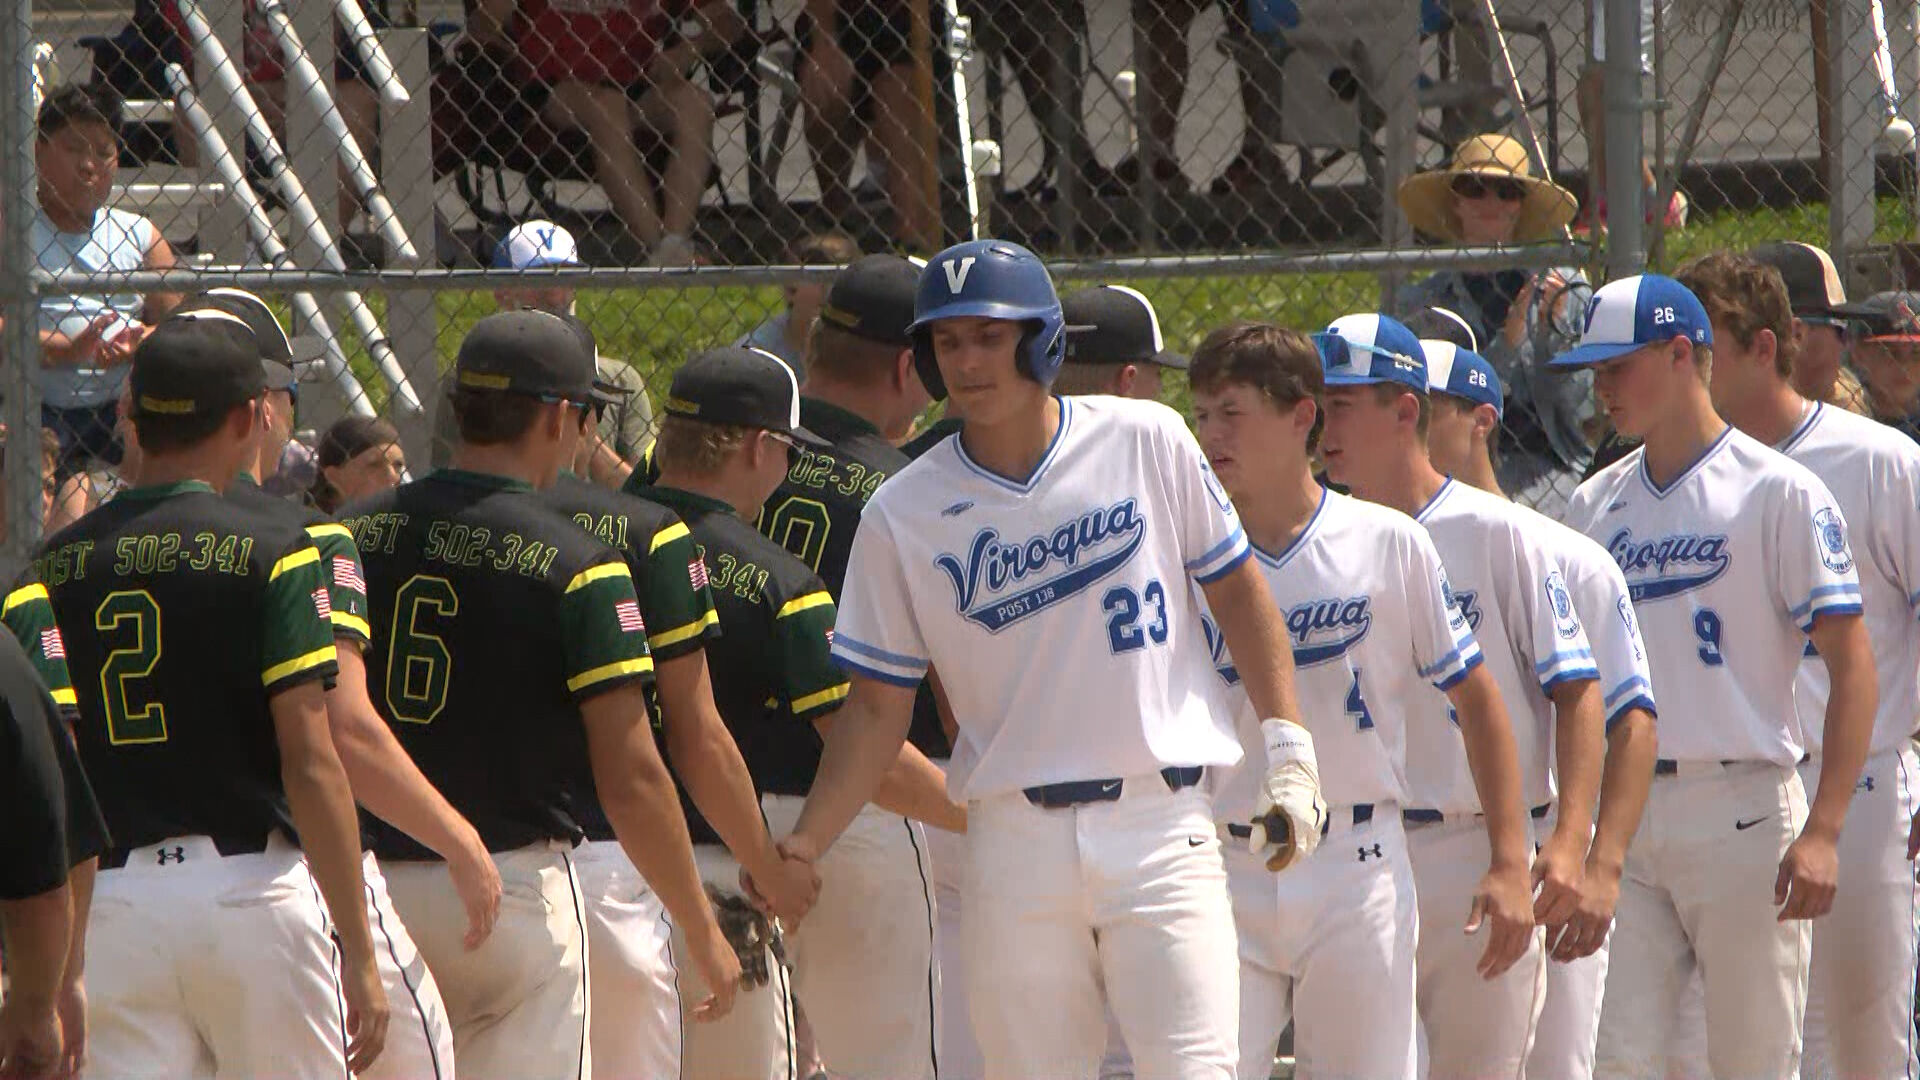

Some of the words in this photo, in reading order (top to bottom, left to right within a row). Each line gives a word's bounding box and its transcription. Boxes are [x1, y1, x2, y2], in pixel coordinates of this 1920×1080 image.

[536, 228, 557, 251] V
[942, 257, 976, 294] V
[1654, 306, 1676, 325] 26
[1469, 369, 1488, 388] 26
[113, 532, 253, 576] 502-341
[424, 521, 558, 579] 502-341
[935, 497, 1143, 613] Viroqua
[997, 597, 1031, 621] POST
[1101, 577, 1169, 654] 23
[385, 574, 458, 724] 6
[1692, 606, 1724, 666] 9
[95, 589, 167, 745] 2
